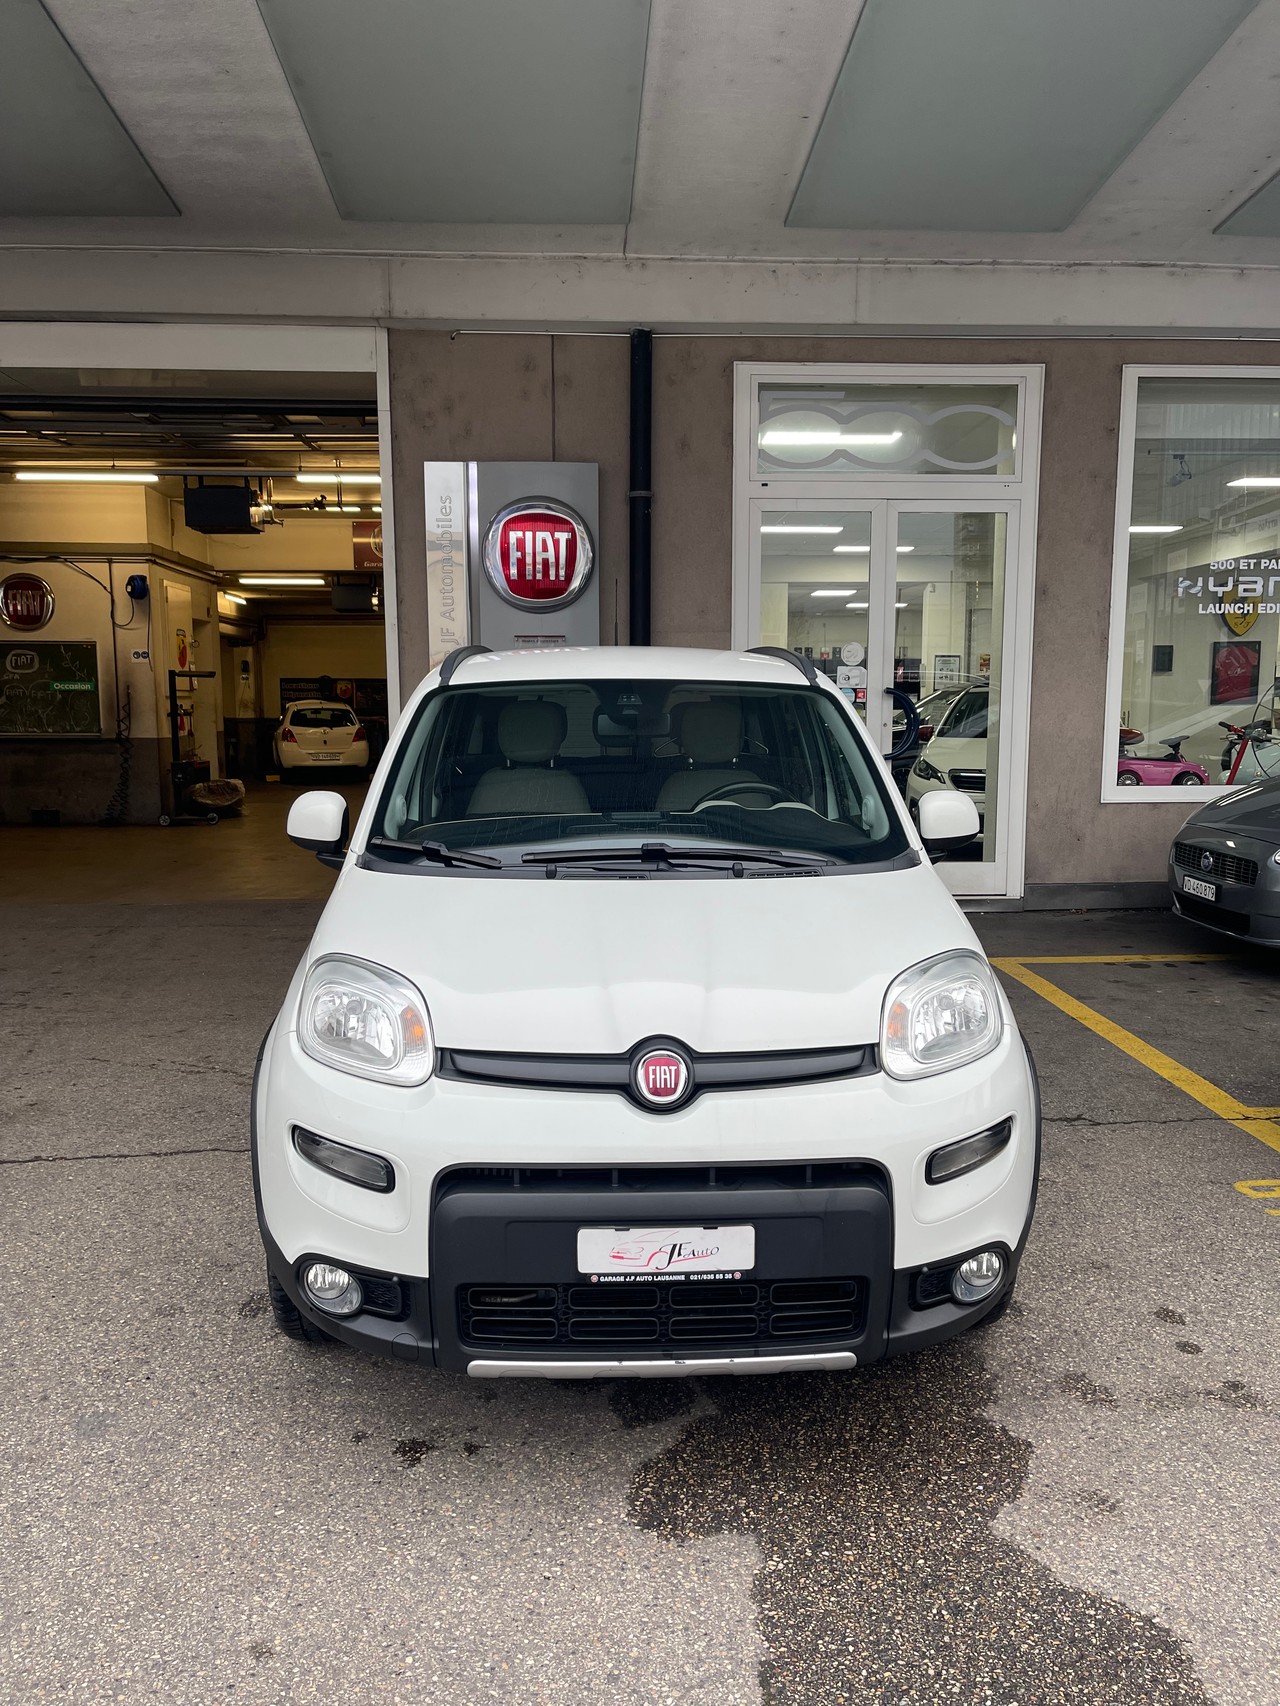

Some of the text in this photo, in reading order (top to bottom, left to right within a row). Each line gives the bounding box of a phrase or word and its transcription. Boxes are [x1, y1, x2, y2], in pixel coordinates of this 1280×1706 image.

[508, 530, 571, 581] FIAT
[1210, 559, 1280, 570] 500 ET PA
[436, 494, 460, 646] JF Automobiles
[7, 590, 42, 616] FIAT
[1198, 603, 1254, 614] LAUNCH
[12, 655, 33, 667] FIAT
[54, 682, 91, 690] Occasion
[648, 1065, 678, 1089] FIAT
